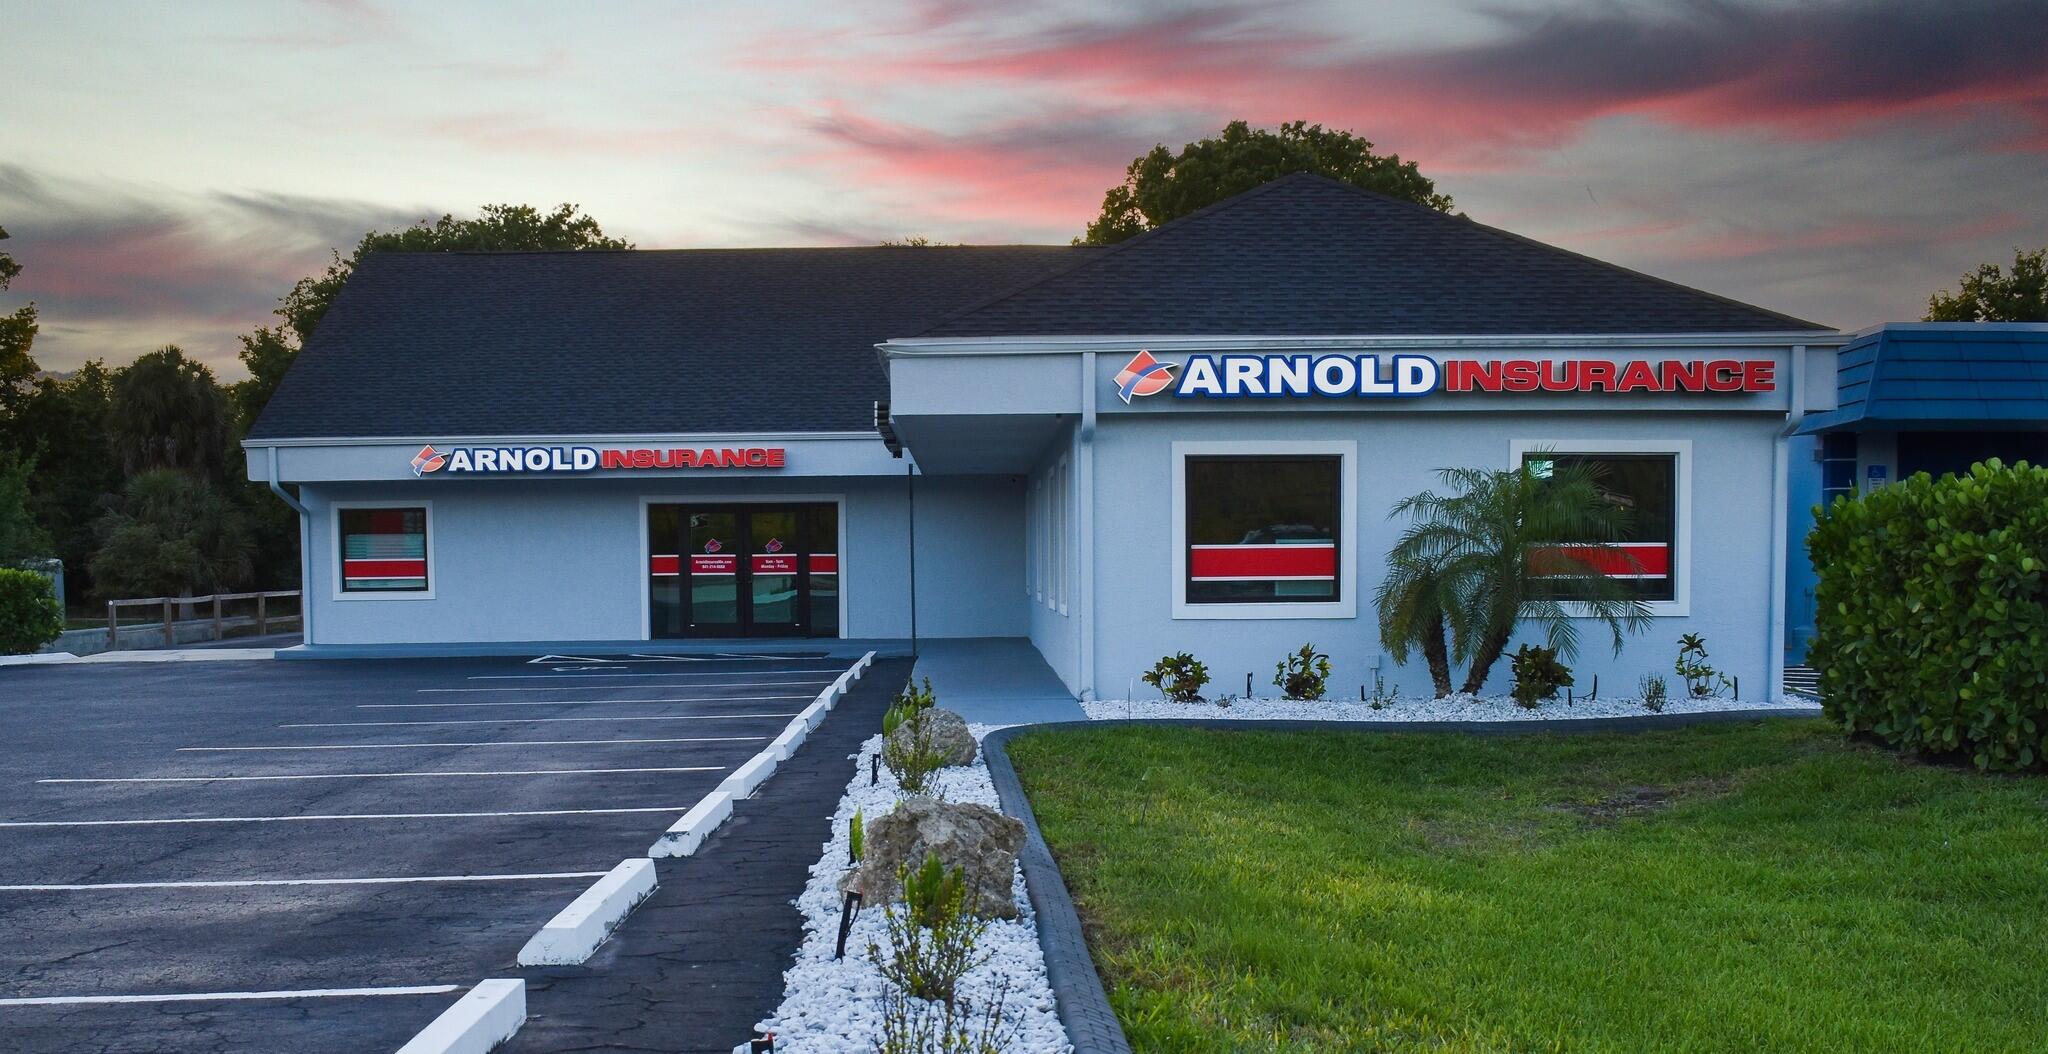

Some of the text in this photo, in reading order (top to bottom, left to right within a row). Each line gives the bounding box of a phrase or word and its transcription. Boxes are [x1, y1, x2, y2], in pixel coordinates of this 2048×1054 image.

[1177, 356, 1776, 396] ARNOLD INSURANCE
[447, 448, 785, 472] ARNOLD INSURANCE
